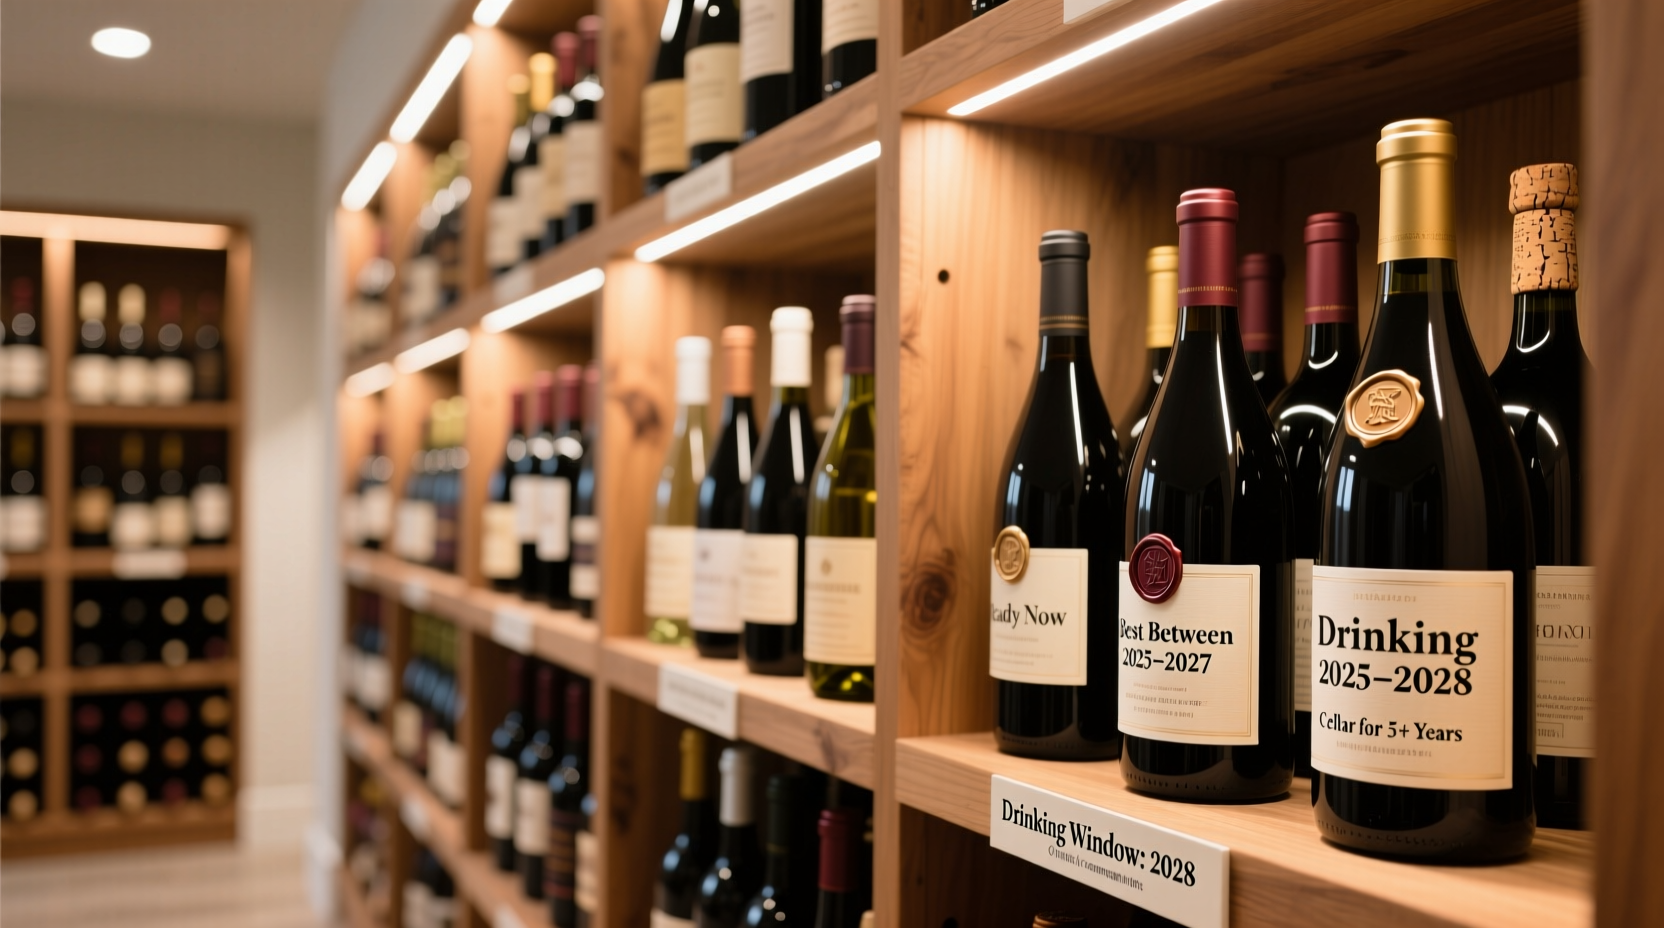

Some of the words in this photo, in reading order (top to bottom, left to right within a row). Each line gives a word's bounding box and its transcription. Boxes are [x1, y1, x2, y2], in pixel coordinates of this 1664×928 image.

[991, 602, 1020, 629] eady
[1024, 604, 1067, 626] Now
[1148, 621, 1234, 645] Between
[1318, 614, 1479, 667] Drinking
[1122, 647, 1213, 674] 2025–2027
[1318, 659, 1473, 696] 2025–2028
[1319, 711, 1357, 734] Cellar
[1359, 717, 1384, 737] for
[1387, 720, 1410, 740] 5+
[1413, 722, 1463, 742] Years
[1002, 798, 1067, 848] Drinking
[1068, 820, 1146, 870] Window:
[1149, 850, 1196, 887] 2028
